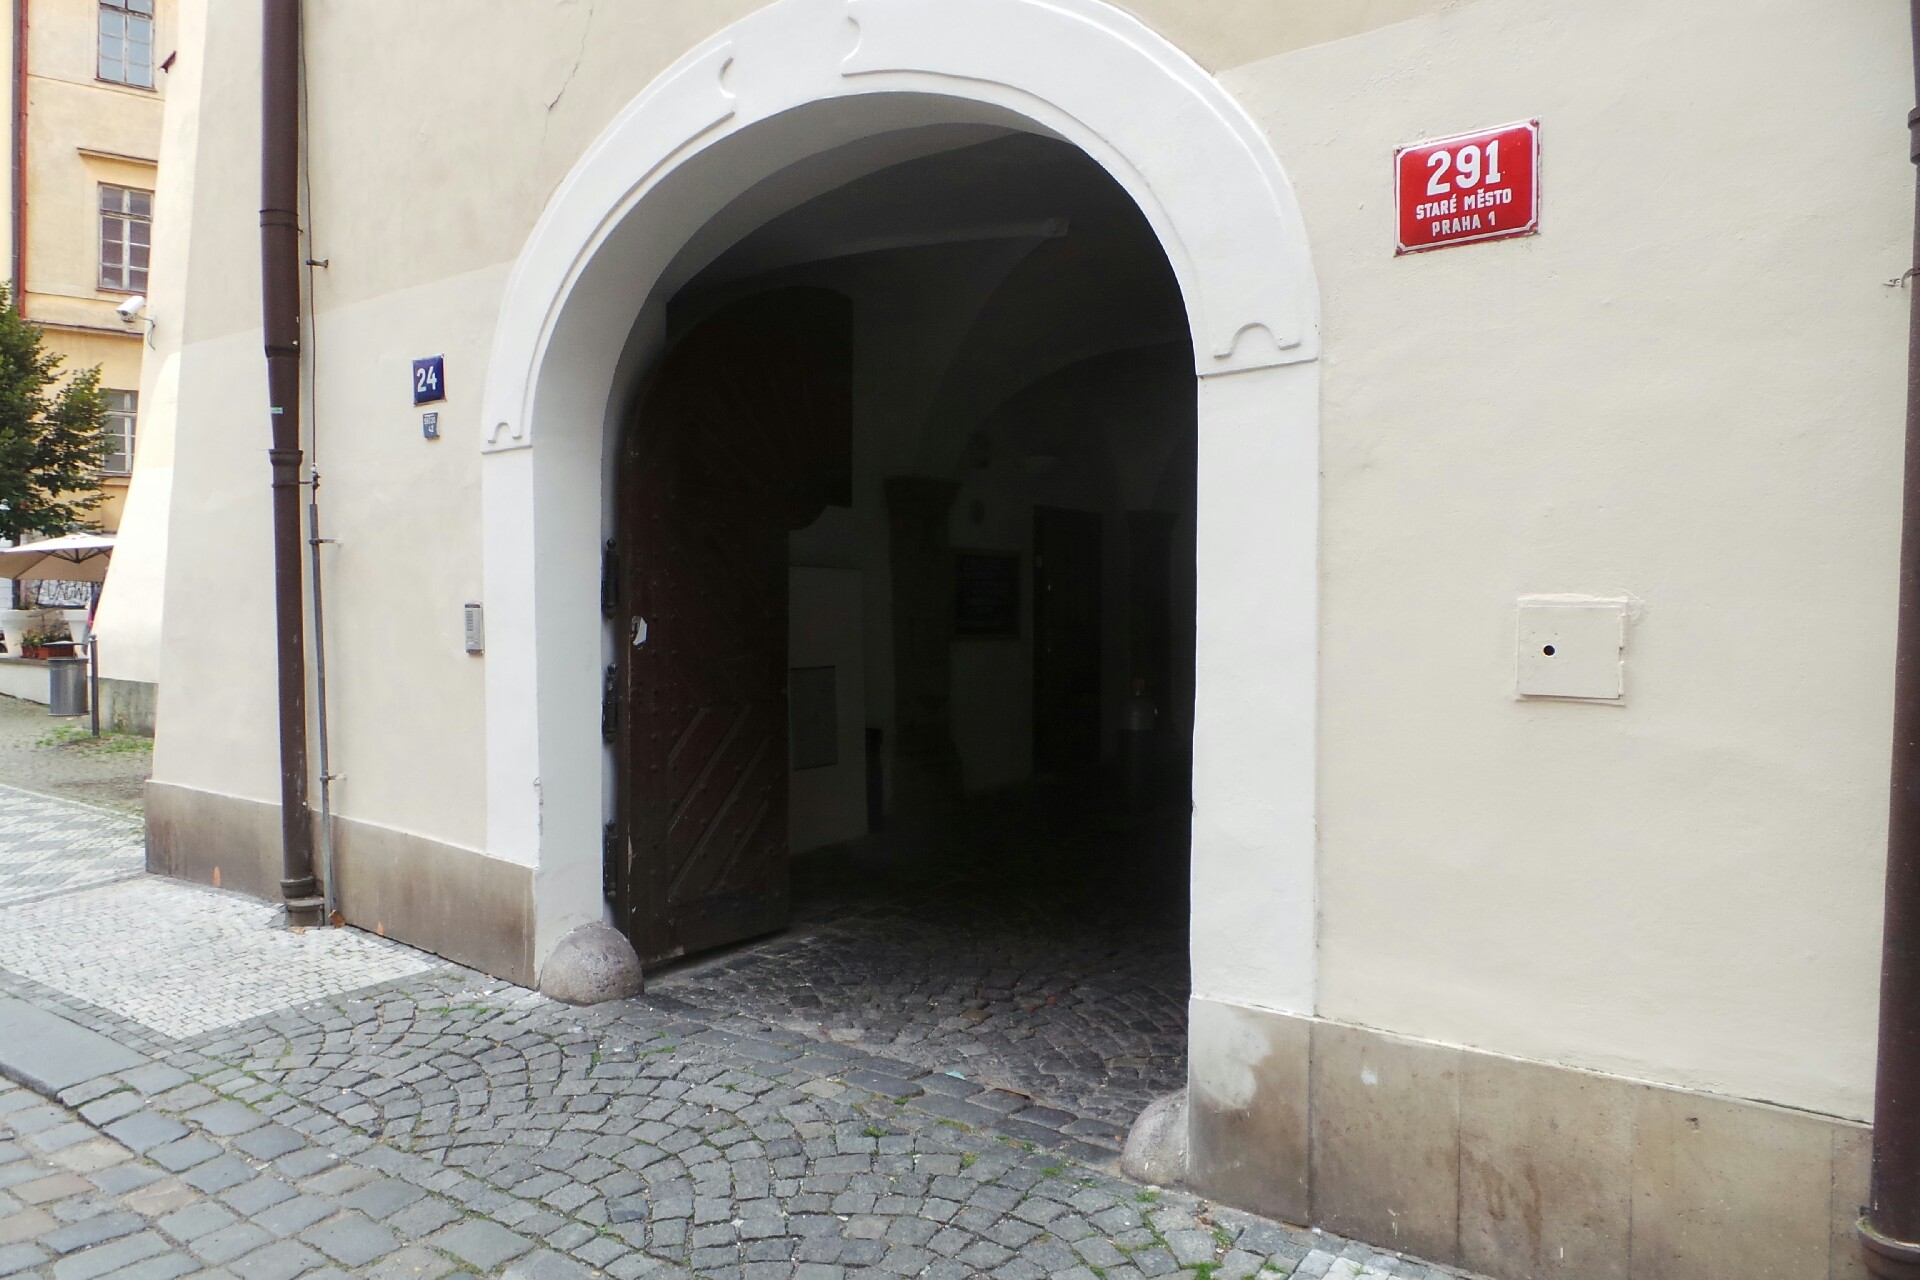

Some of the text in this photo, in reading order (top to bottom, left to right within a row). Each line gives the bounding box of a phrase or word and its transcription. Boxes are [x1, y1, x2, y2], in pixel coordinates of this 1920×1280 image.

[1426, 140, 1501, 196] 291
[1416, 188, 1512, 220] STARÉ MĚSTO
[1432, 211, 1496, 237] PRAHA 1
[416, 365, 437, 393] 24
